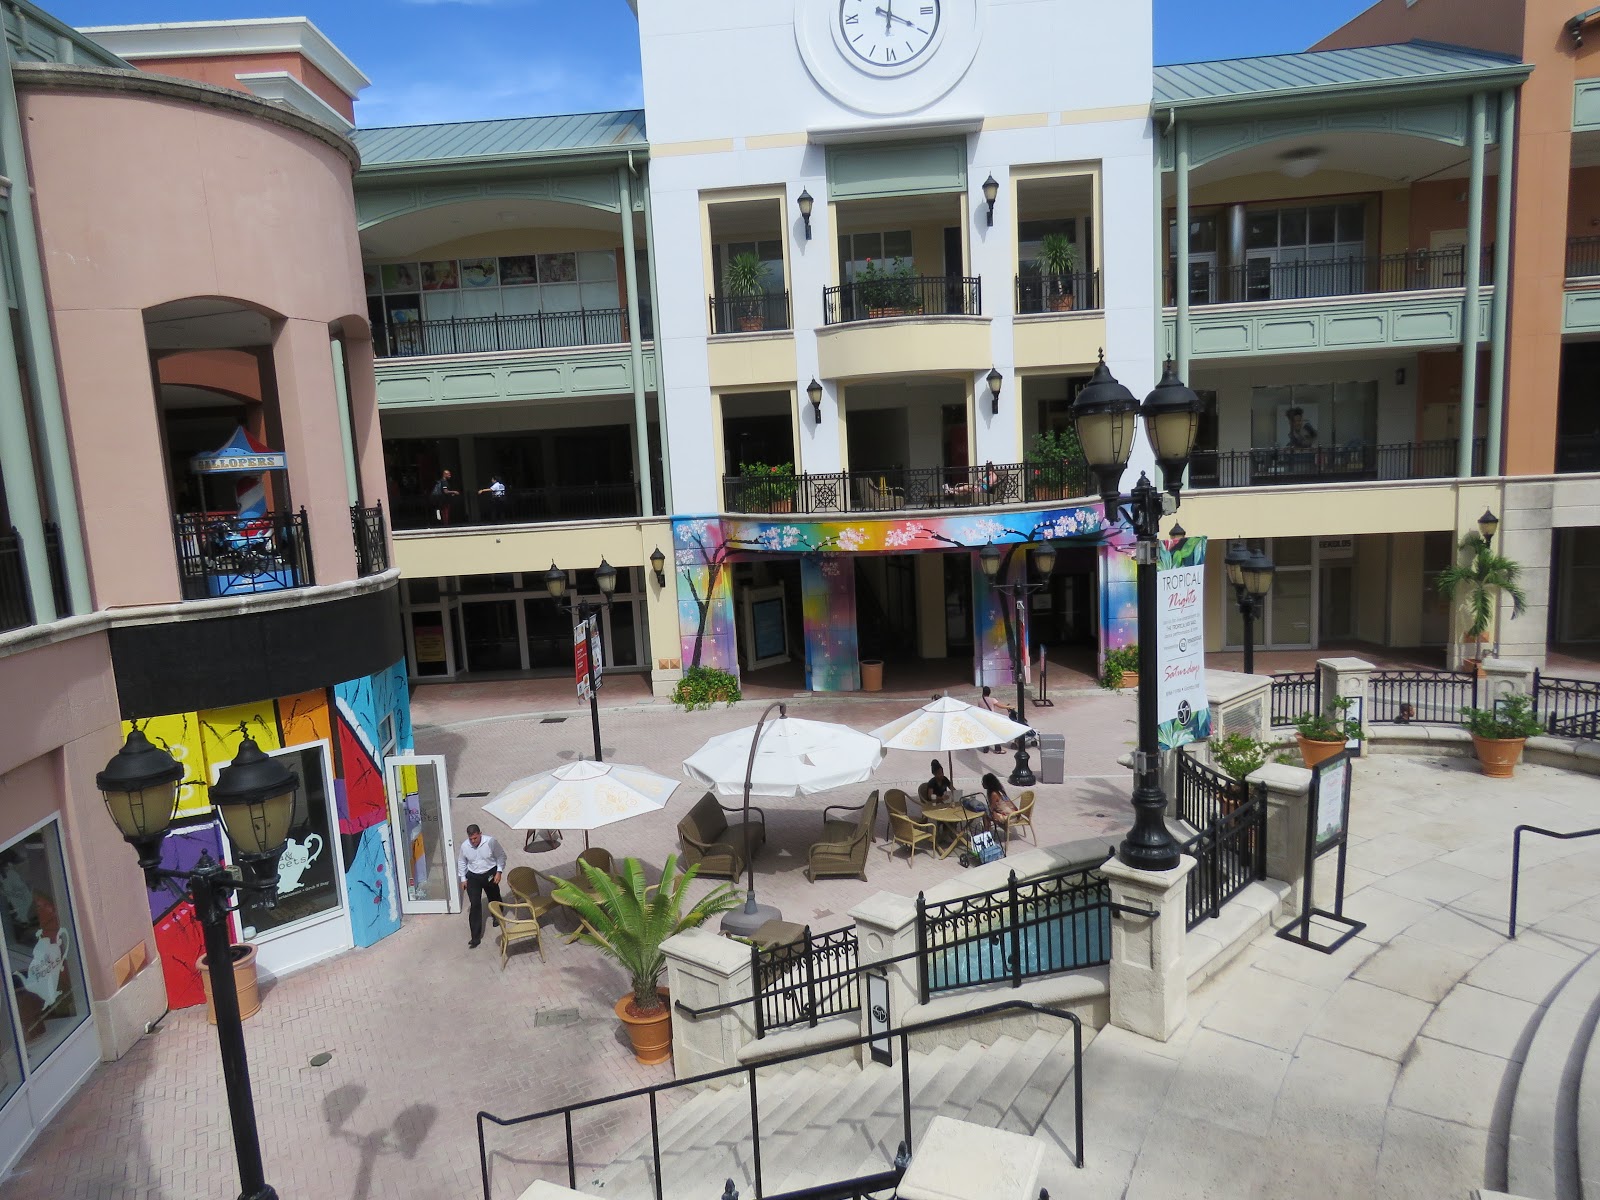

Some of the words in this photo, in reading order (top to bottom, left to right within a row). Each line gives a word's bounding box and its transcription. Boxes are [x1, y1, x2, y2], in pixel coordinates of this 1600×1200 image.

[1162, 571, 1201, 591] TROPICAL
[1168, 588, 1197, 613] Nights
[1164, 661, 1200, 683] Saturday
[278, 857, 307, 870] oets
